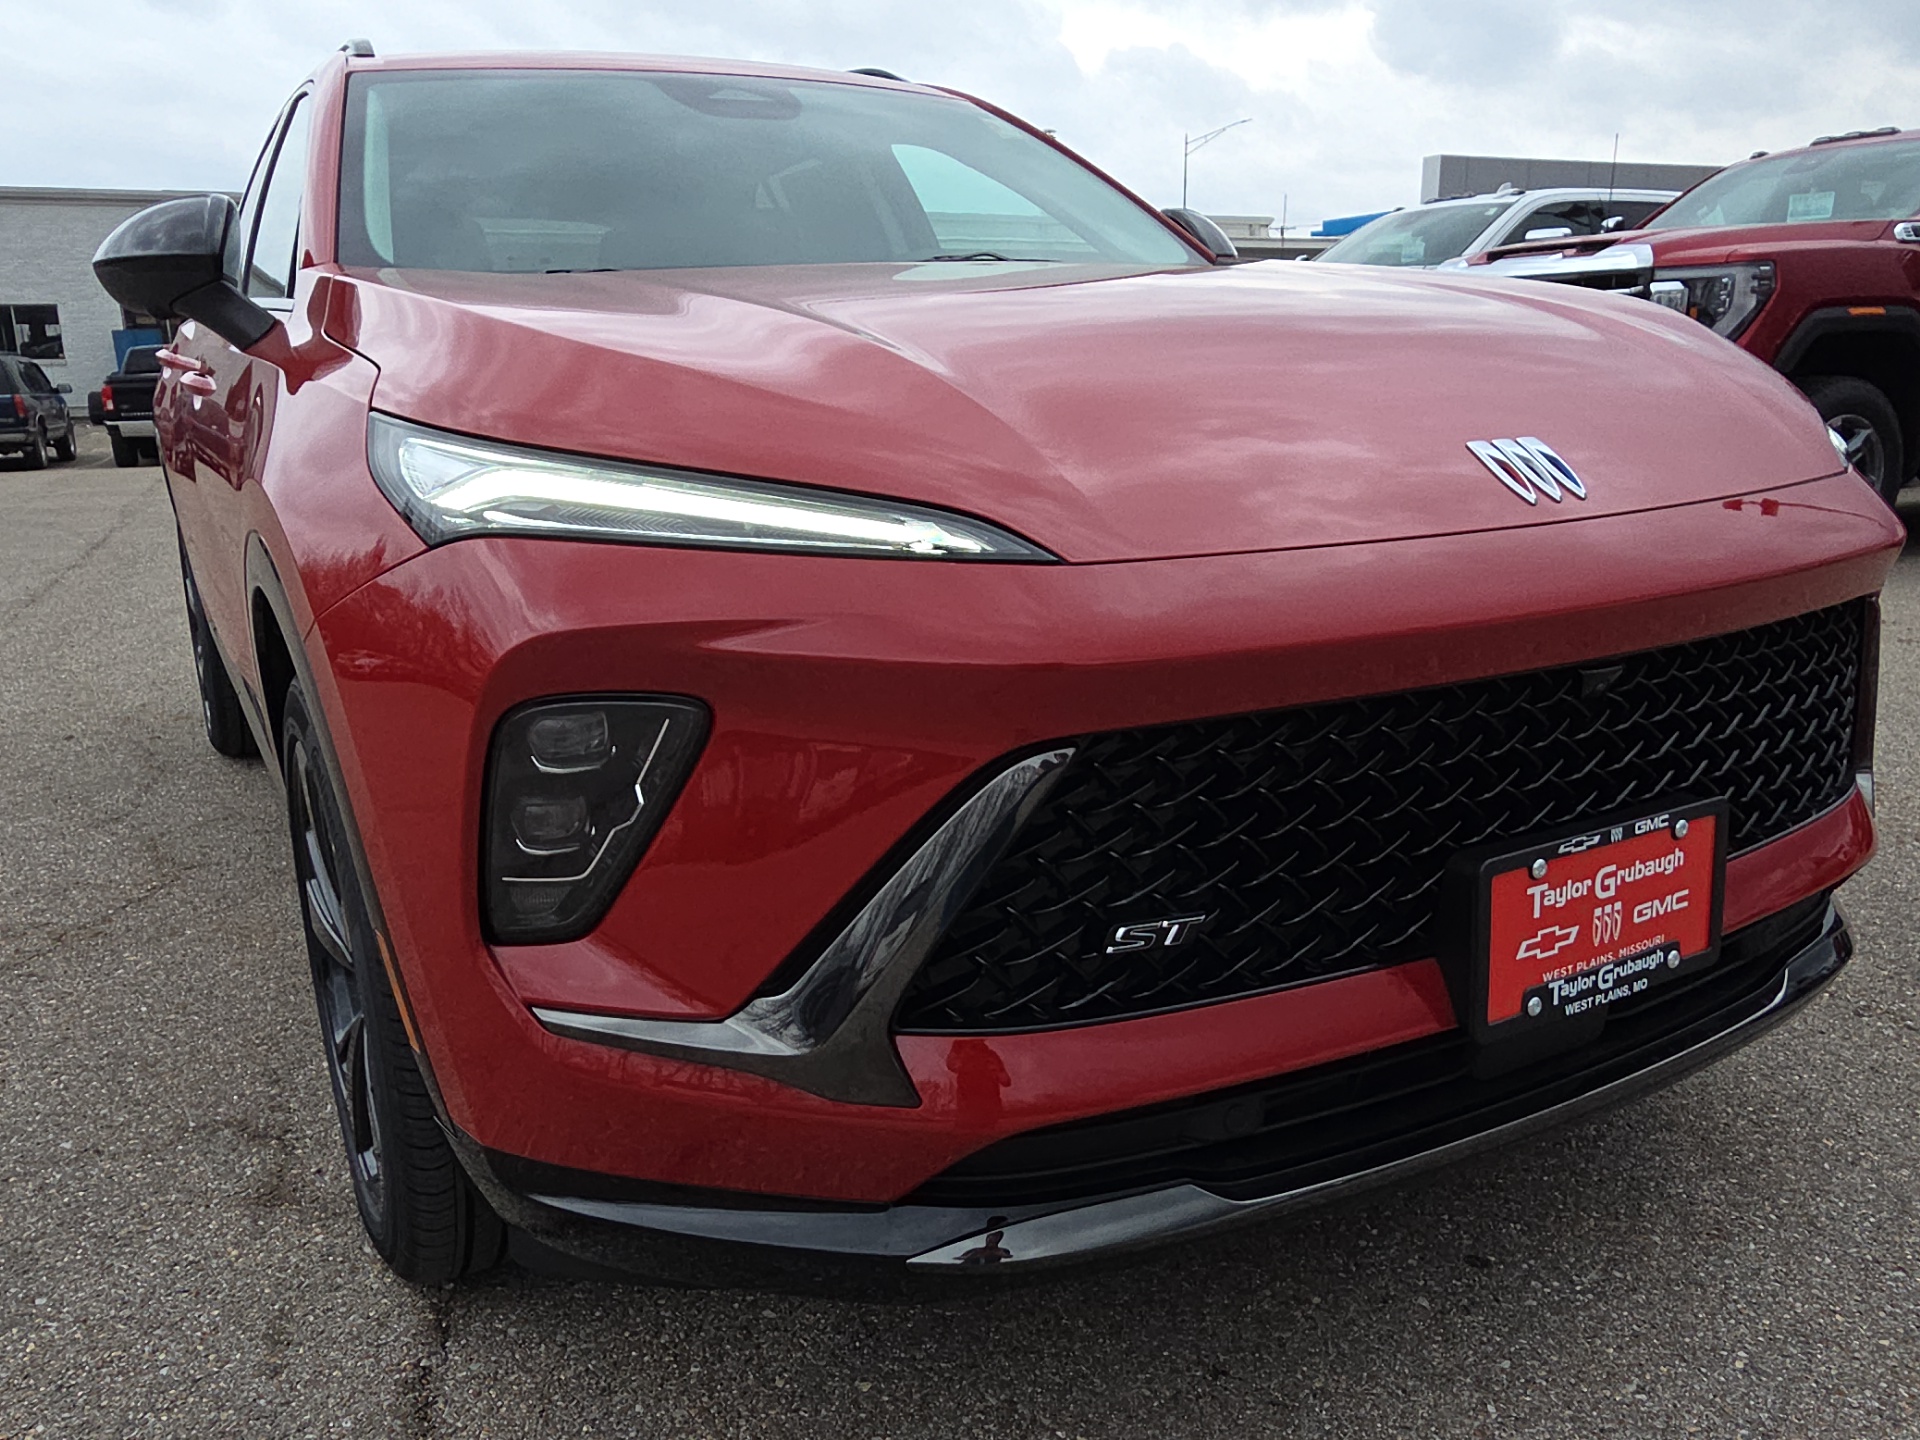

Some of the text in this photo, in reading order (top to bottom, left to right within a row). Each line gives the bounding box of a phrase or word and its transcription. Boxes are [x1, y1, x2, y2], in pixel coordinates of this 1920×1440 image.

[1634, 814, 1670, 835] GMC
[1526, 847, 1684, 919] Taylor Grubaugh
[1632, 889, 1690, 924] GMC
[1106, 914, 1205, 954] ST
[1542, 964, 1573, 983] WEST
[1618, 934, 1665, 958] MISSOURI
[1548, 949, 1664, 1006] Taylor Grubaugh
[1565, 996, 1594, 1017] WEST
[1632, 978, 1648, 993] MO
